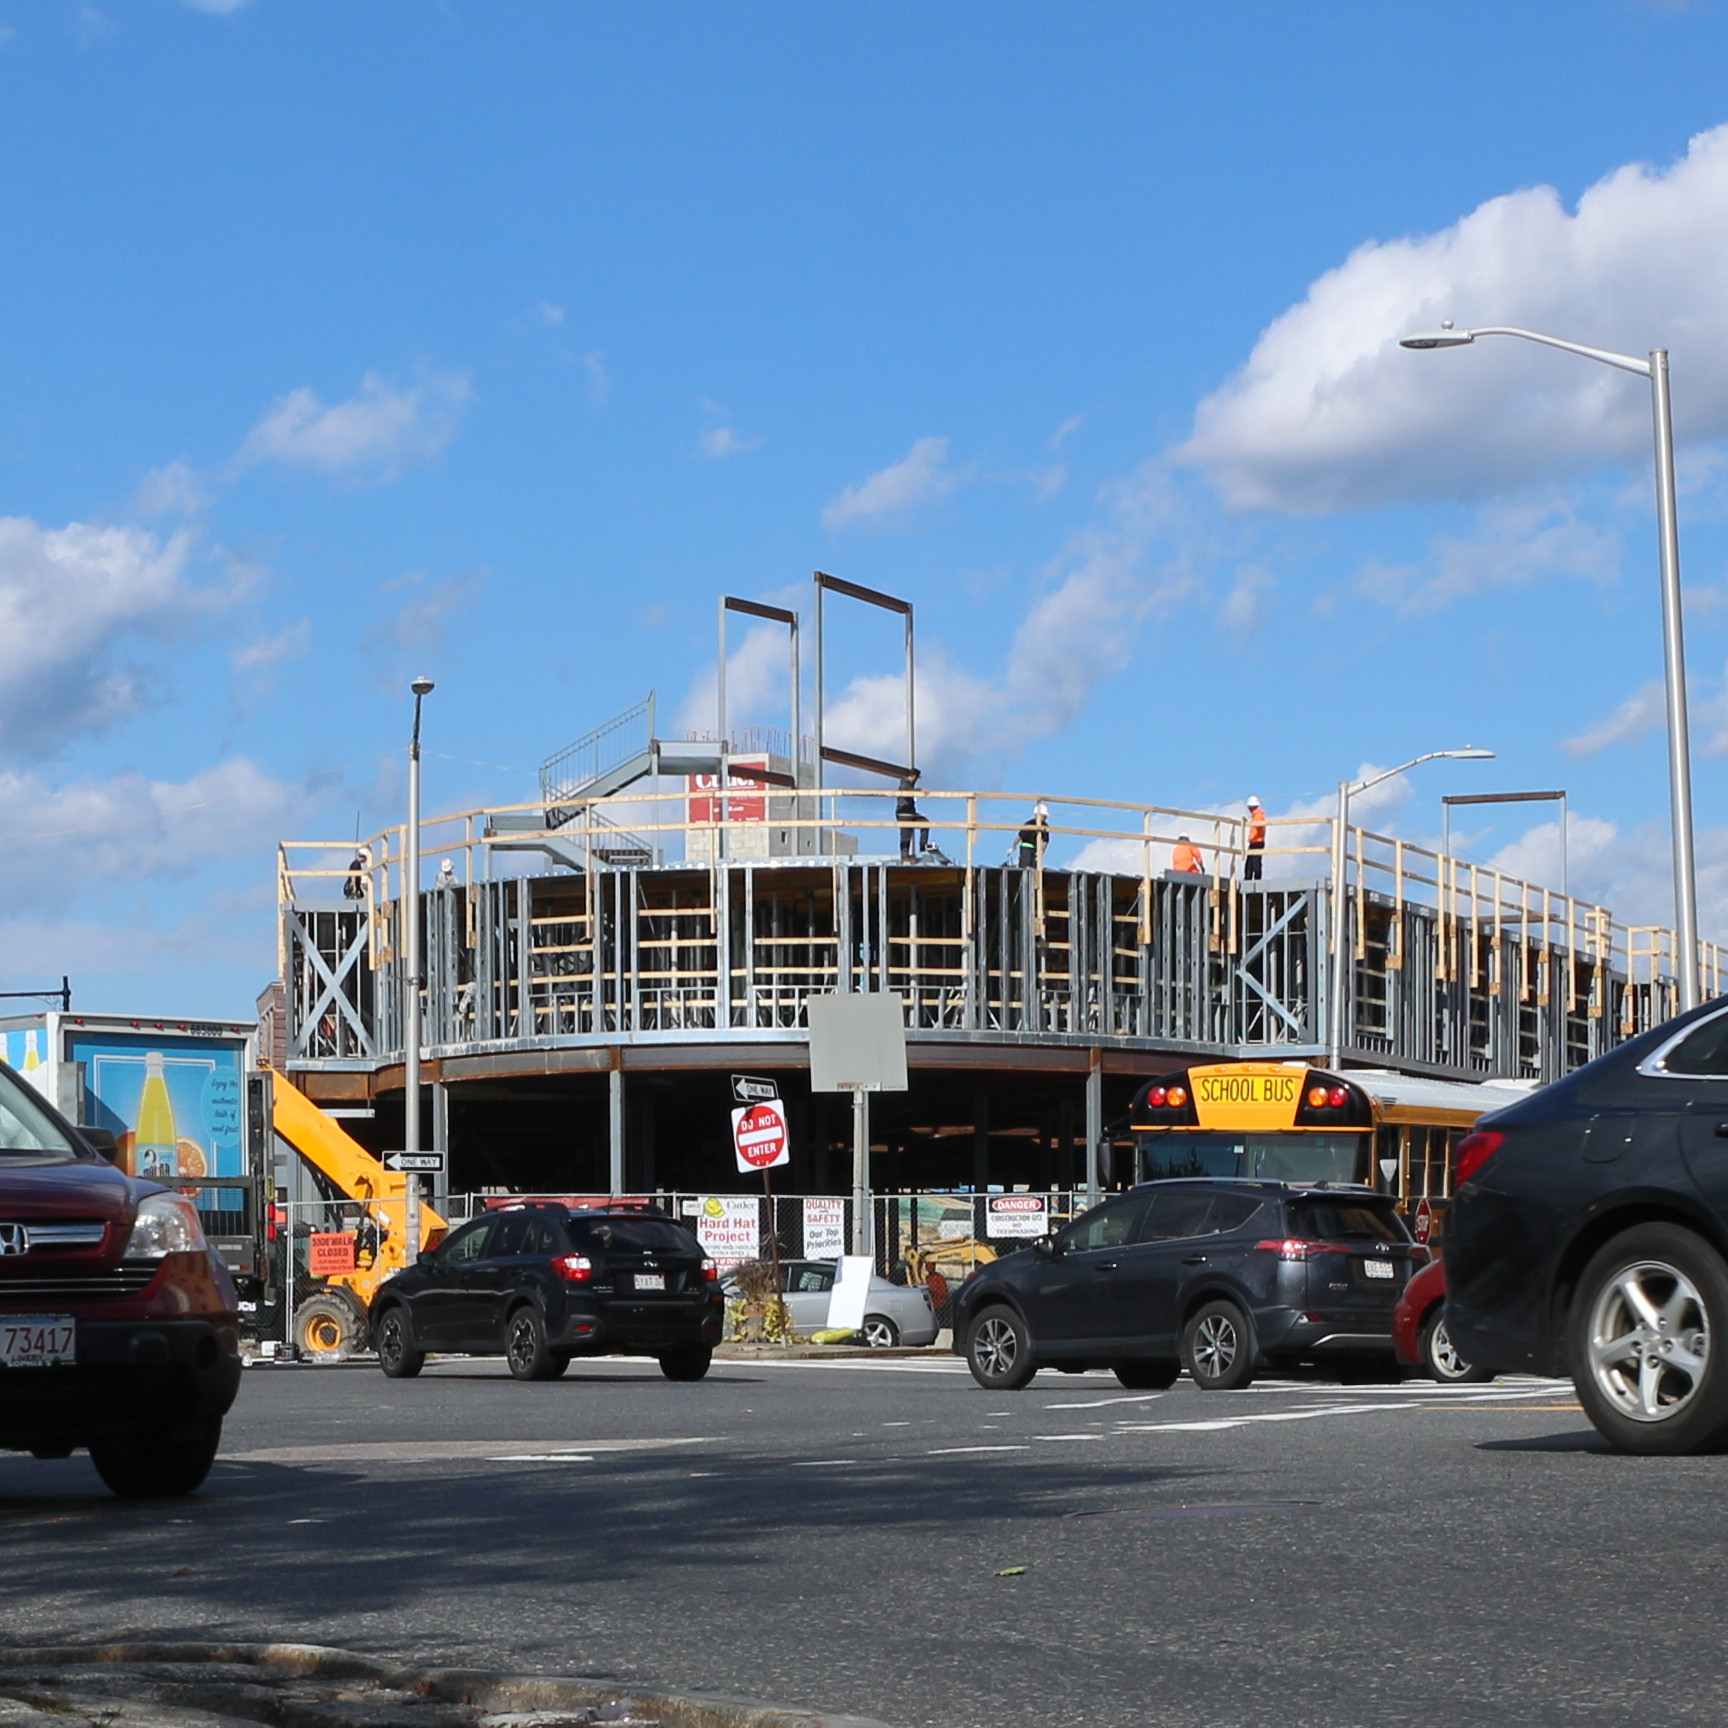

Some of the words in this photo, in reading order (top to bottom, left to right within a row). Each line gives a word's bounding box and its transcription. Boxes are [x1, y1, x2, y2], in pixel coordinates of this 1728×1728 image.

[1201, 1078, 1260, 1102] SCHOOL
[1263, 1078, 1294, 1102] BUS
[741, 1119, 754, 1131] DO
[758, 1114, 776, 1127] NOT
[747, 1142, 777, 1158] ENTER
[401, 1157, 417, 1166] ONE
[420, 1157, 437, 1166] WAY
[806, 1199, 841, 1210] QUALITY
[998, 1200, 1036, 1210] DANGER
[699, 1218, 730, 1229] Hard
[734, 1218, 756, 1229] Hat
[807, 1214, 840, 1223] SAFETY
[312, 1237, 353, 1247] SIDEWALK
[705, 1231, 751, 1243] Project
[318, 1247, 349, 1257] CLOSED
[237, 1301, 257, 1311] JCB
[4, 1326, 74, 1355] 73417
